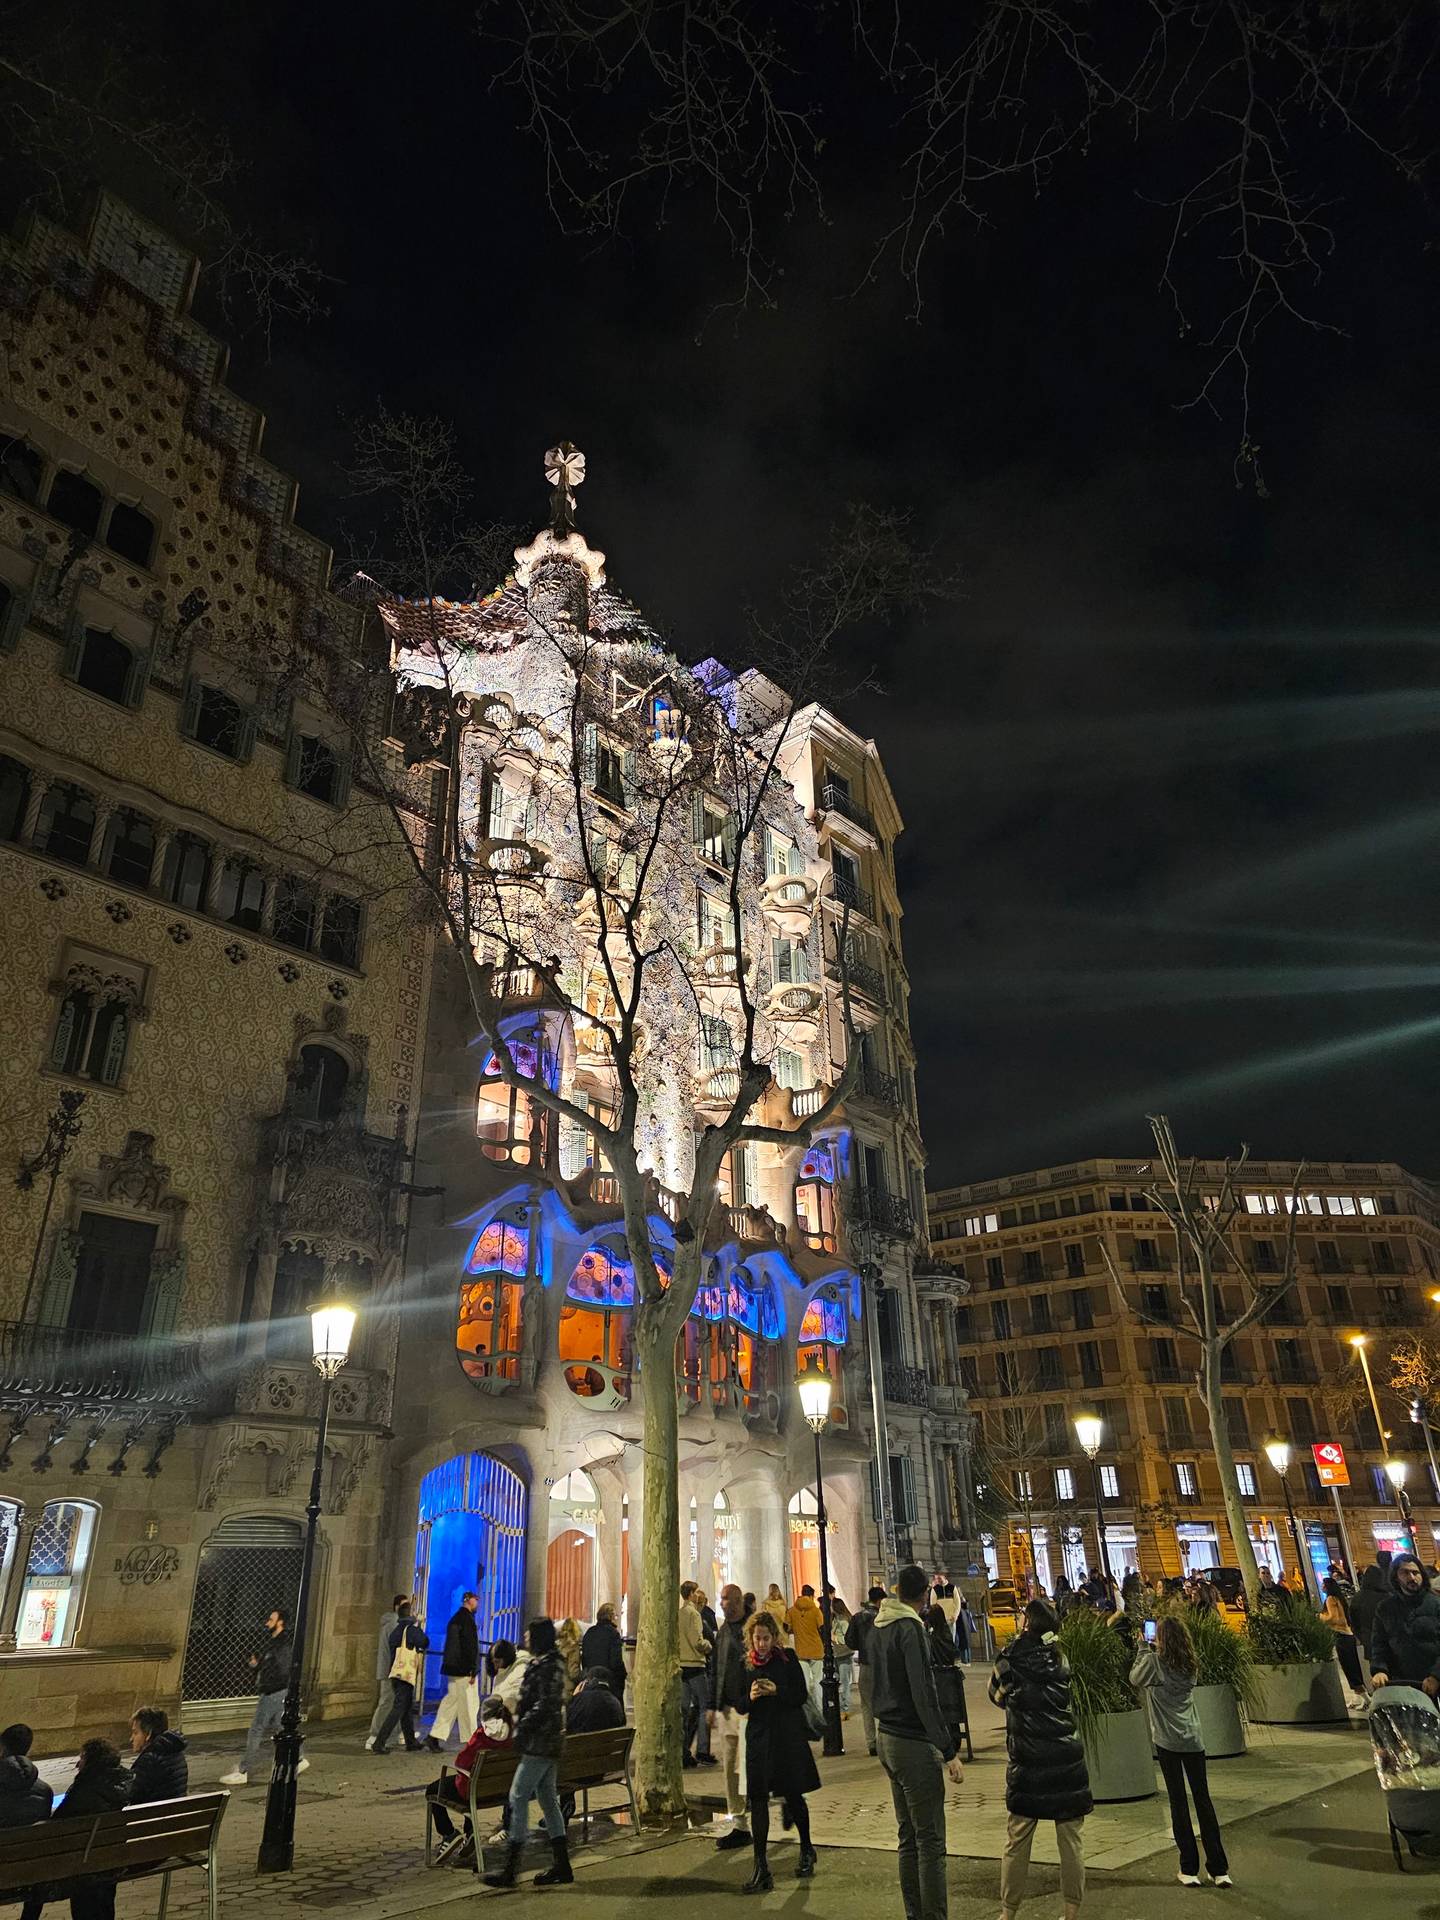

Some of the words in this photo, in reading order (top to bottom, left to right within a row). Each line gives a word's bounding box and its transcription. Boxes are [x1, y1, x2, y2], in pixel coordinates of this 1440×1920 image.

[1325, 1449, 1334, 1457] M
[572, 1508, 606, 1525] CASA
[713, 1512, 741, 1530] AUDÍ
